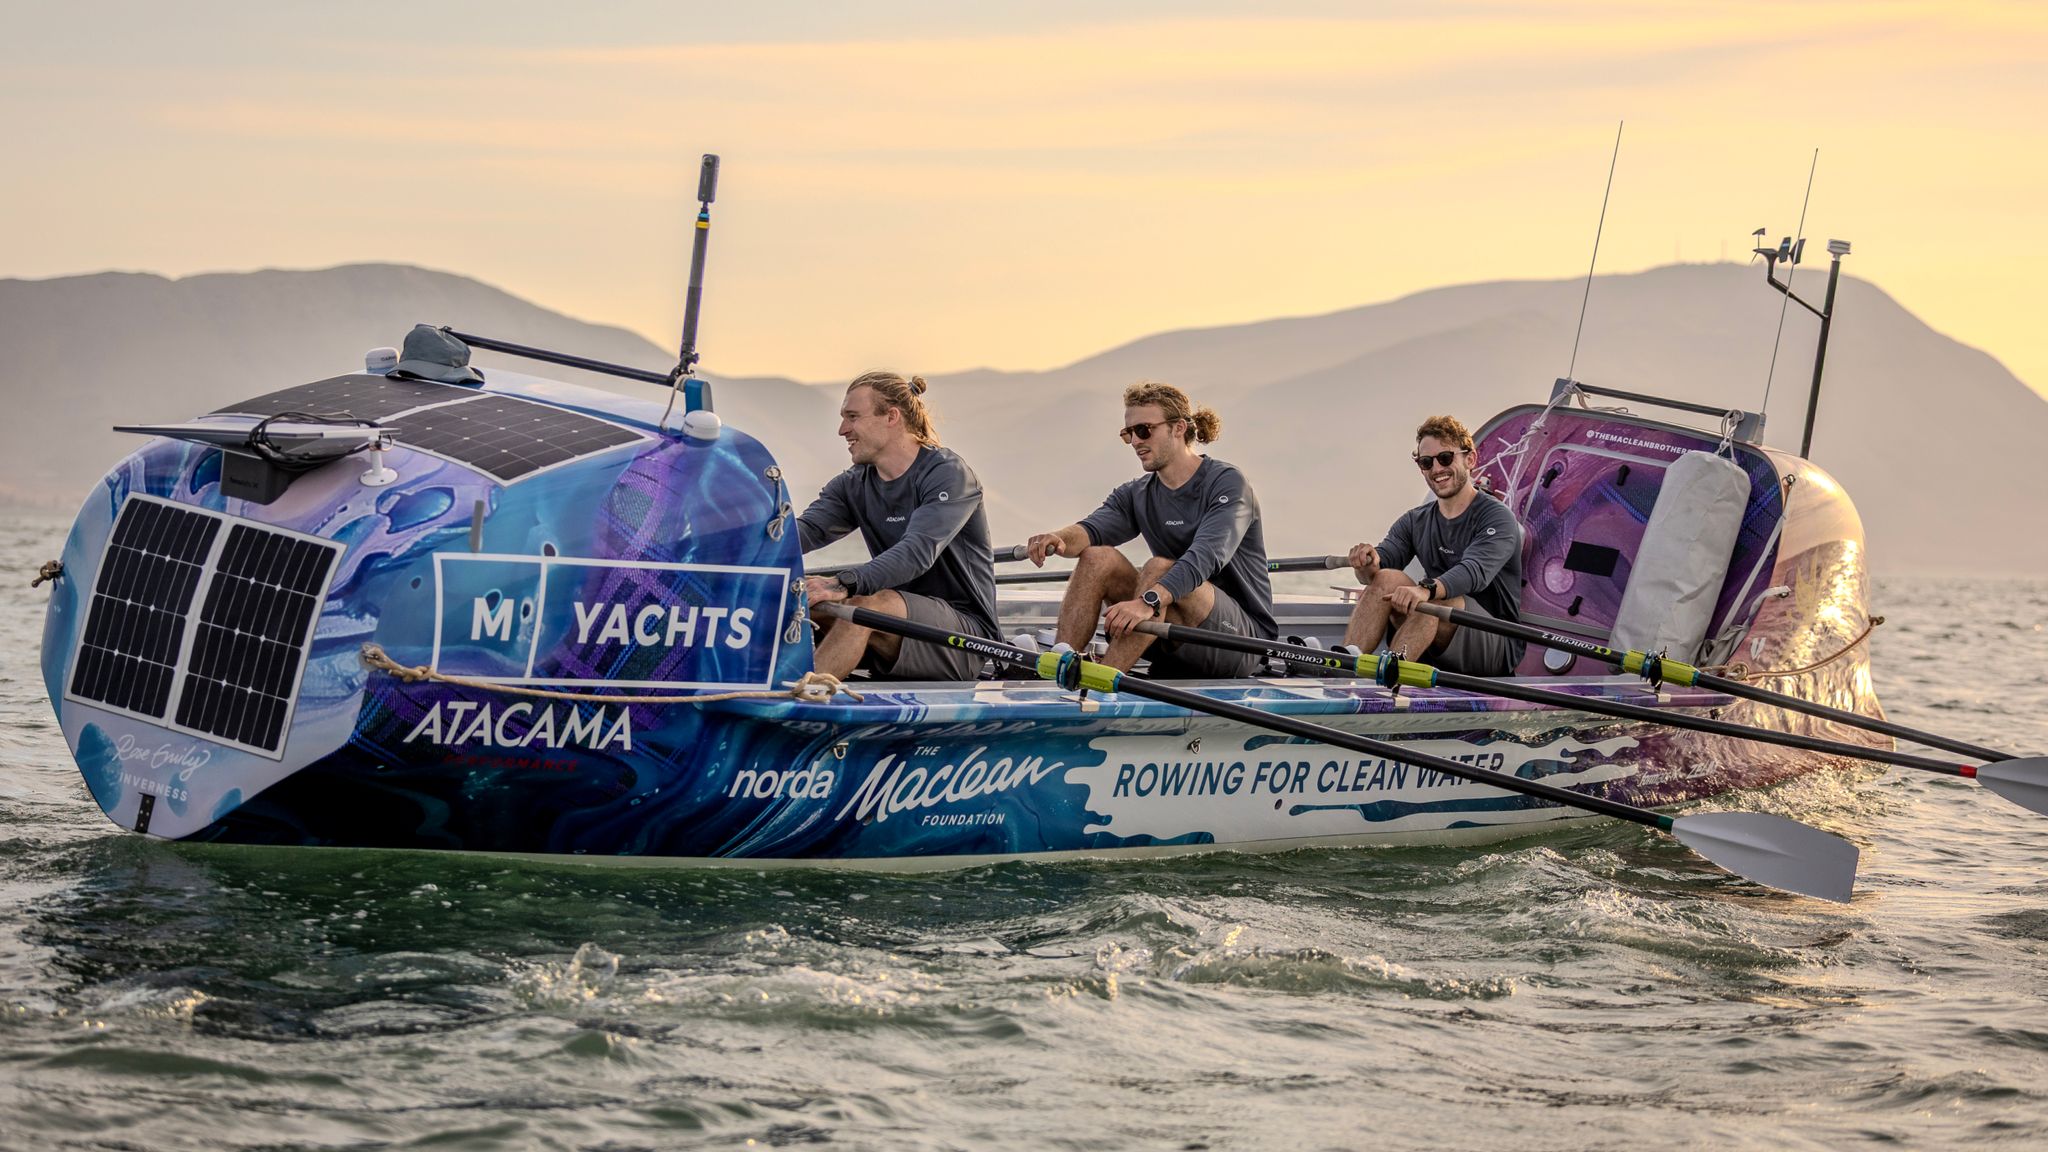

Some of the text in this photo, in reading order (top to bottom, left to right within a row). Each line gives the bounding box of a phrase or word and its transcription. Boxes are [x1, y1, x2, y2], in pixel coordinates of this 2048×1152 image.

[1586, 429, 1695, 455] @THEMACLEANBROTHER
[573, 601, 755, 650] YACHTS
[965, 641, 1024, 662] concept 2
[1541, 631, 1595, 651] concept 2
[1266, 648, 1324, 664] concept 2
[403, 701, 632, 751] ATACAMA
[112, 734, 150, 763] Rose
[914, 745, 941, 756] THE
[118, 771, 189, 802] INVERNESS
[728, 761, 836, 799] norda
[834, 745, 1065, 824] Maclean
[1112, 761, 1245, 798] ROWING
[1251, 760, 1310, 795] FOR
[1316, 758, 1410, 793] CLEAN
[921, 813, 1006, 827] FOUNDATION
